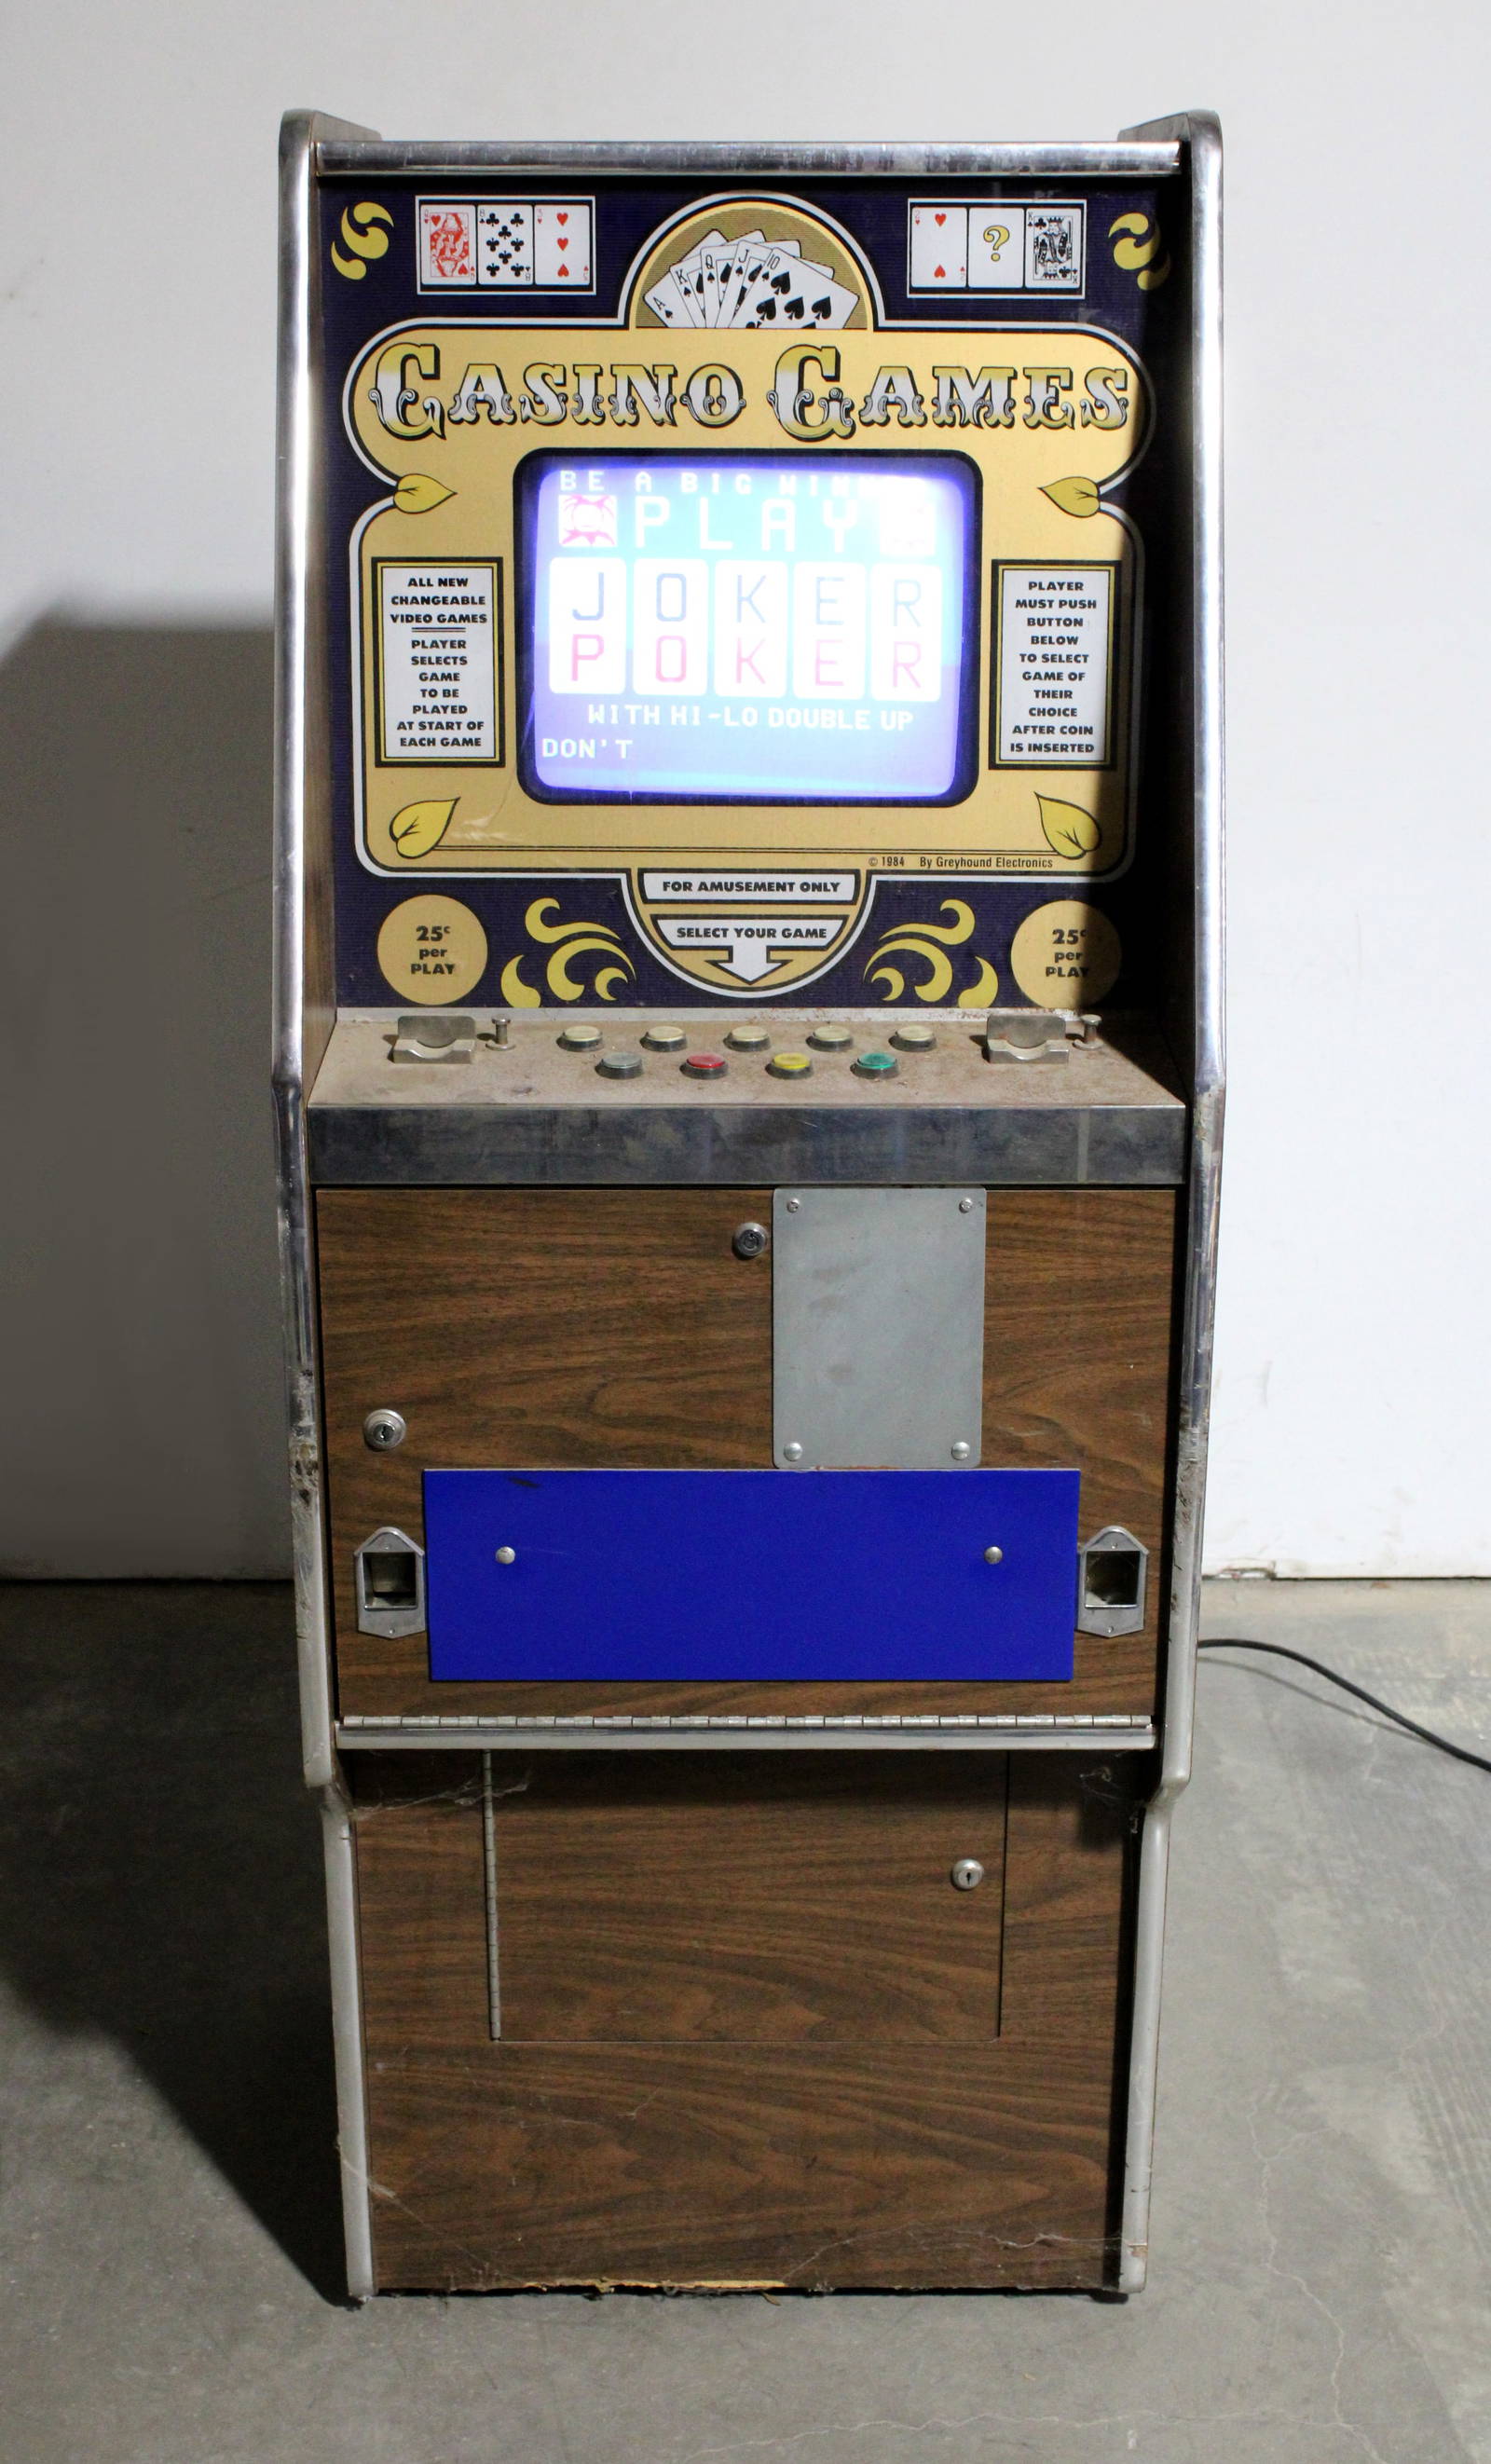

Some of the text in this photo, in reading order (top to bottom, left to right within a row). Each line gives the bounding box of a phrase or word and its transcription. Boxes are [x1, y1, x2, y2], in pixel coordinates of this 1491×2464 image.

[983, 225, 1010, 262] ?
[705, 254, 714, 269] Q
[738, 249, 749, 263] J
[767, 255, 781, 270] 10
[676, 270, 688, 285] K
[653, 296, 666, 310] A
[368, 341, 1129, 443] CASINO GAMES
[560, 470, 604, 491] BE
[635, 472, 652, 492] A
[680, 472, 753, 495] BIG
[635, 495, 858, 554] PLAY
[407, 577, 469, 587] ALL NEW
[1028, 582, 1084, 591] PLAYER
[390, 595, 486, 606] CHANGEABLE
[571, 571, 922, 627] JOKER
[1015, 599, 1097, 609] MUST PUSH
[390, 613, 487, 623] VIDEO GAMES
[1027, 617, 1083, 627] BUTTON
[411, 639, 466, 649] PLAYER
[1031, 636, 1078, 645] BELOW
[411, 656, 468, 665] SELECTS
[571, 634, 922, 689] POKER
[1019, 653, 1089, 664] TO SELECT
[418, 672, 460, 682] GAME
[1022, 671, 1086, 681] GAME OF
[420, 689, 459, 698] TO BE
[1033, 690, 1073, 699] THEIR
[412, 705, 468, 714] PLAYED
[1029, 707, 1077, 717] CHOICE
[588, 704, 914, 732] WITH HI-LO DOUBLE UP
[396, 721, 485, 731] AT START OF
[1012, 725, 1093, 735] AFTER COIN
[400, 737, 481, 746] EACH GAME
[541, 738, 633, 760] DON'T
[1010, 743, 1094, 753] IS INSERTED
[869, 856, 1053, 869] © 1984 By Greyhound Electronics
[663, 882, 841, 893] FOR AMUSEMENT ONLY
[677, 927, 827, 938] SELECT YOUR GAME
[418, 948, 447, 960] per
[1054, 951, 1083, 963] per
[410, 964, 455, 975] PLAY
[1045, 966, 1089, 978] PLAY
